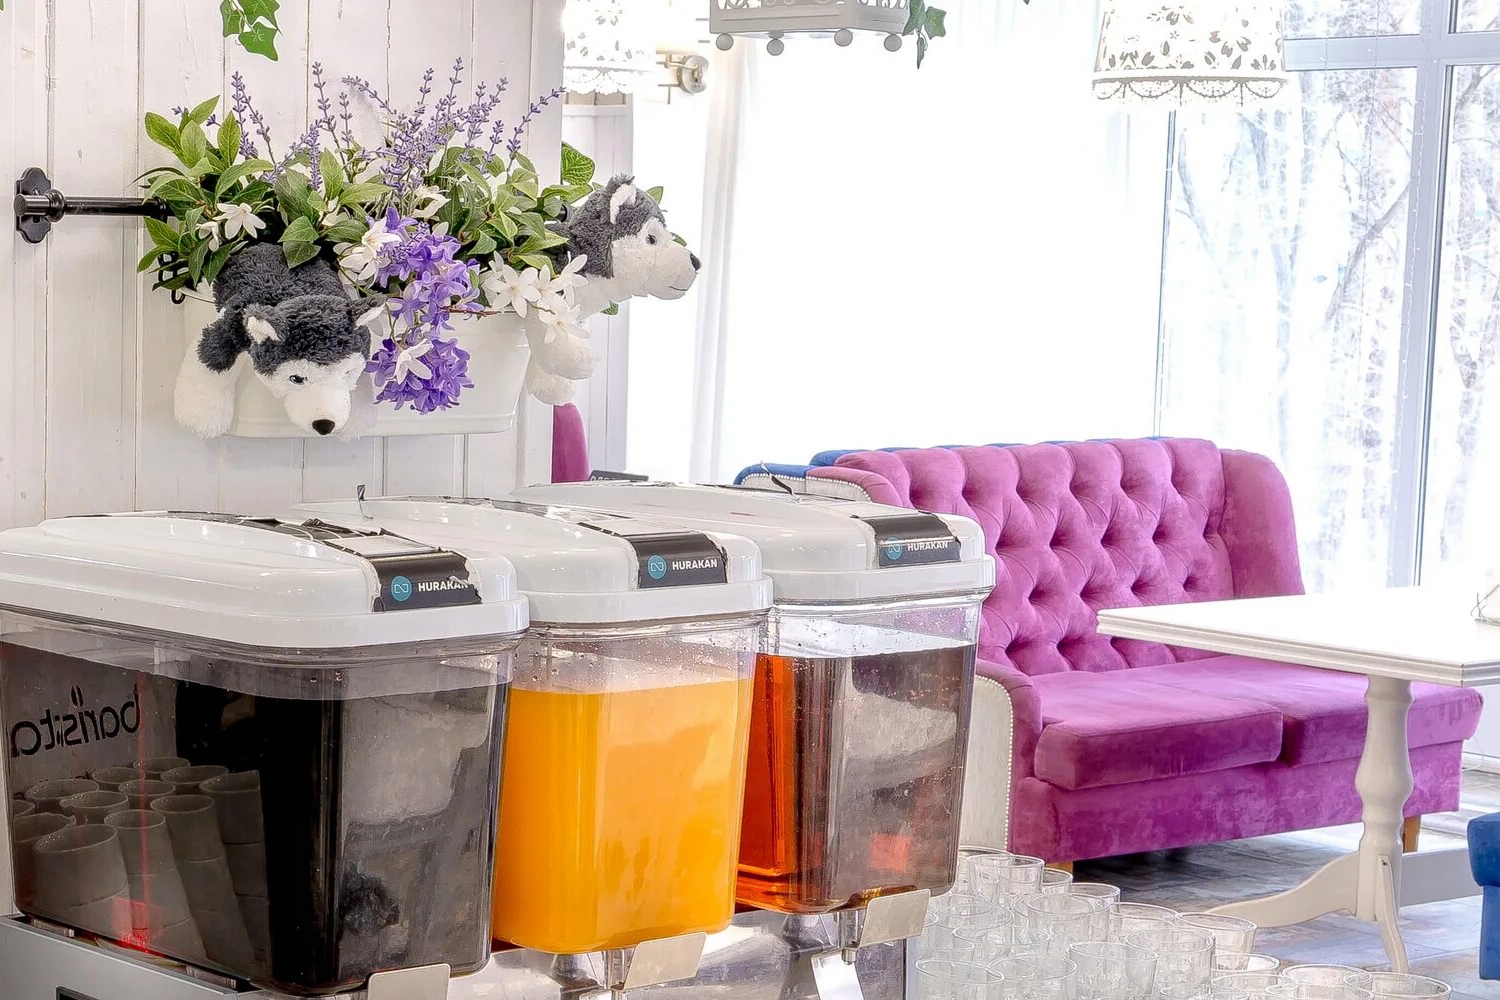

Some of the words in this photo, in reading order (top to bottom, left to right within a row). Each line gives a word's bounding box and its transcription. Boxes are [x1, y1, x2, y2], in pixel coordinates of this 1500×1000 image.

[906, 541, 948, 551] HURAKAN
[672, 559, 717, 570] HURAKAN
[418, 579, 468, 592] HURAKAN
